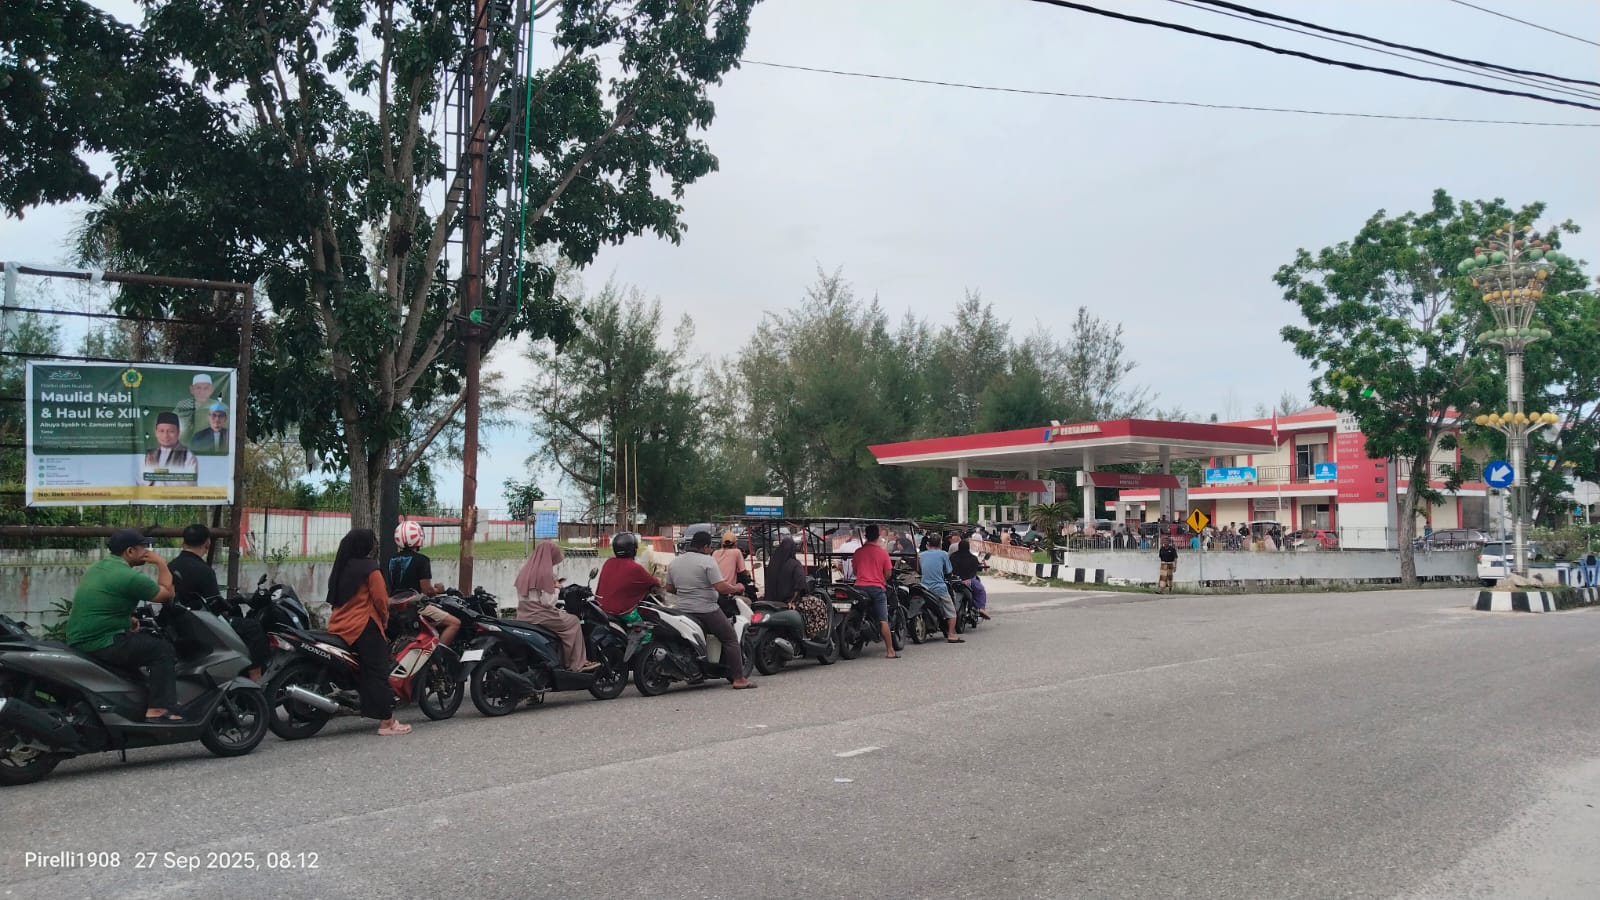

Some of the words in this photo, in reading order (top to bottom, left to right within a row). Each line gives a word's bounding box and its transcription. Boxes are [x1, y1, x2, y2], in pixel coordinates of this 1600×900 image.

[41, 391, 93, 403] Maulid
[97, 391, 132, 403] Nabi
[41, 407, 52, 419] &
[56, 407, 91, 419] Haul
[96, 407, 114, 419] ke
[118, 407, 141, 419] XIII
[300, 642, 332, 661] HONDA
